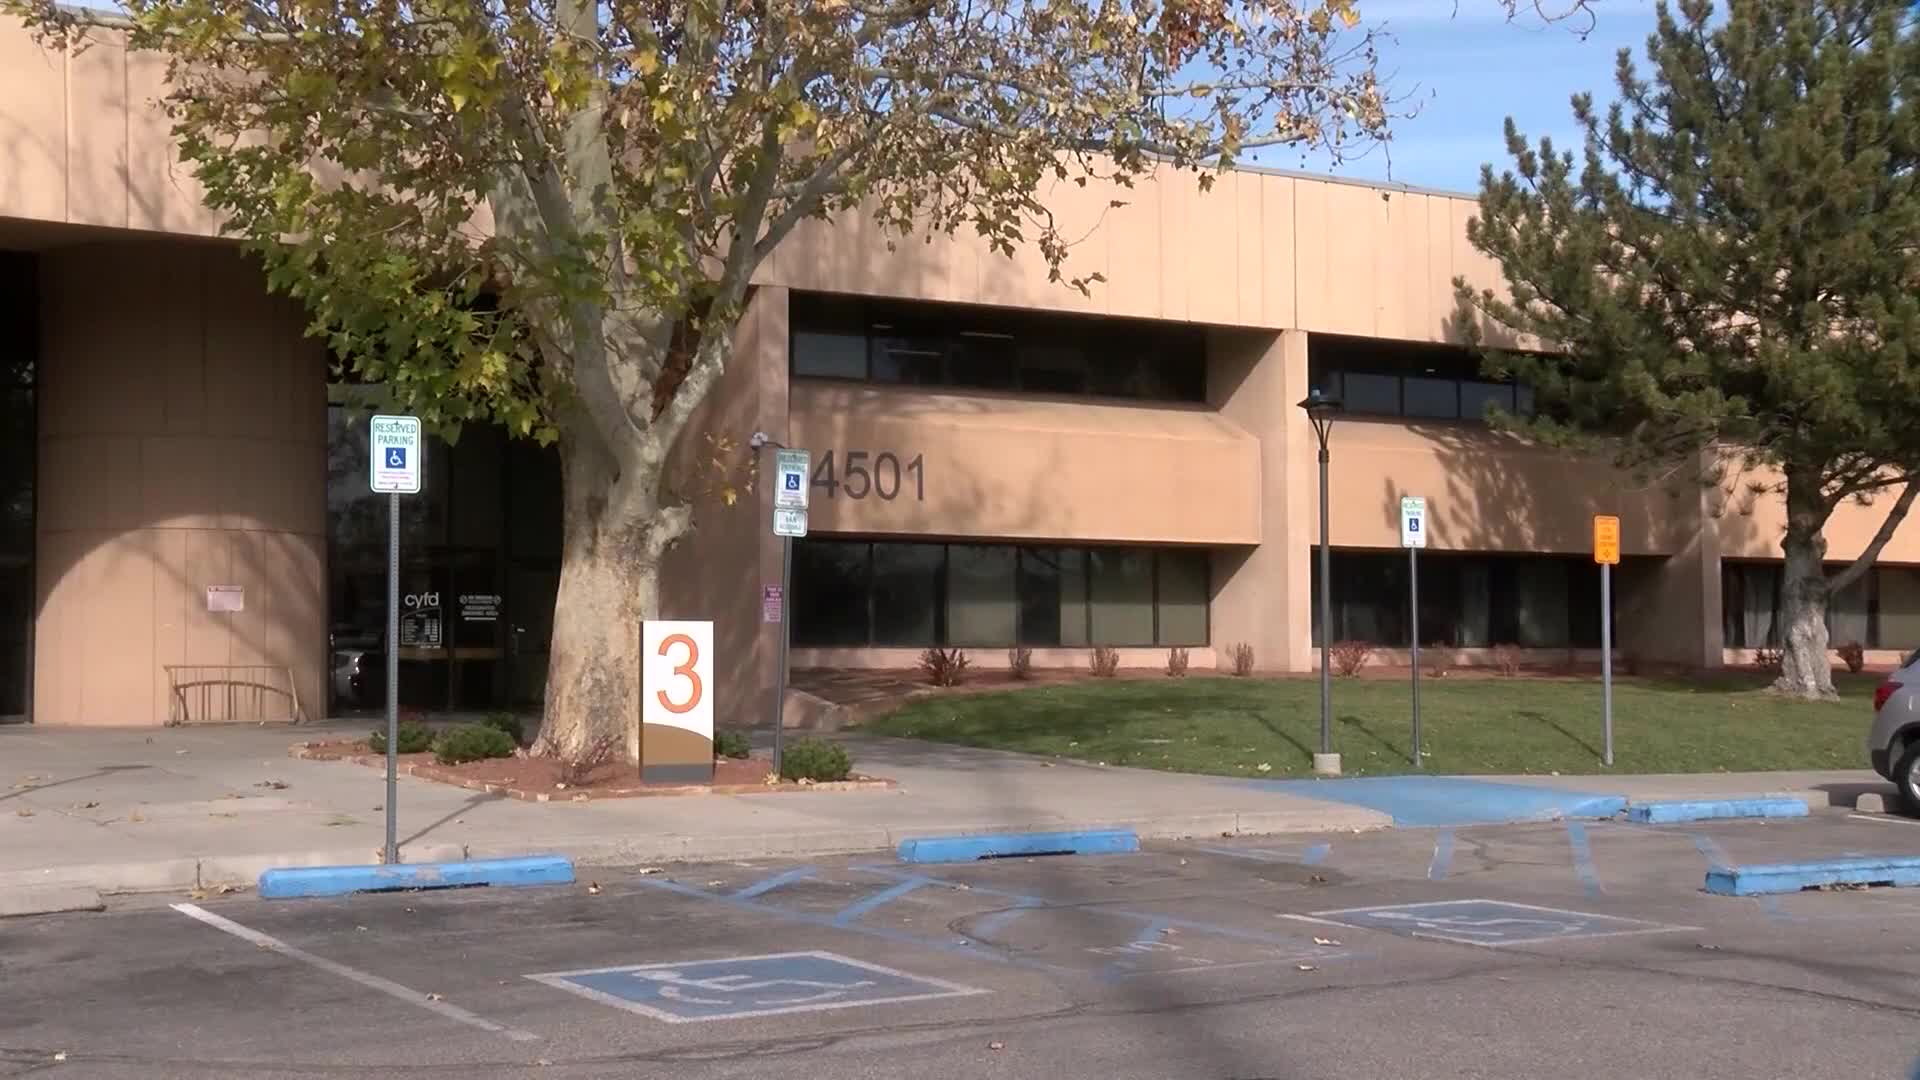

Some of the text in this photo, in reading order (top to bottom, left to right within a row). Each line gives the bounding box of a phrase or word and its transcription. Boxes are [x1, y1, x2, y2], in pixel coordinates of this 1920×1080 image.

[375, 423, 417, 434] RESERVED
[377, 435, 414, 445] PARKING
[810, 449, 924, 501] 4501
[404, 592, 440, 609] cyfd
[656, 633, 703, 714] 3
